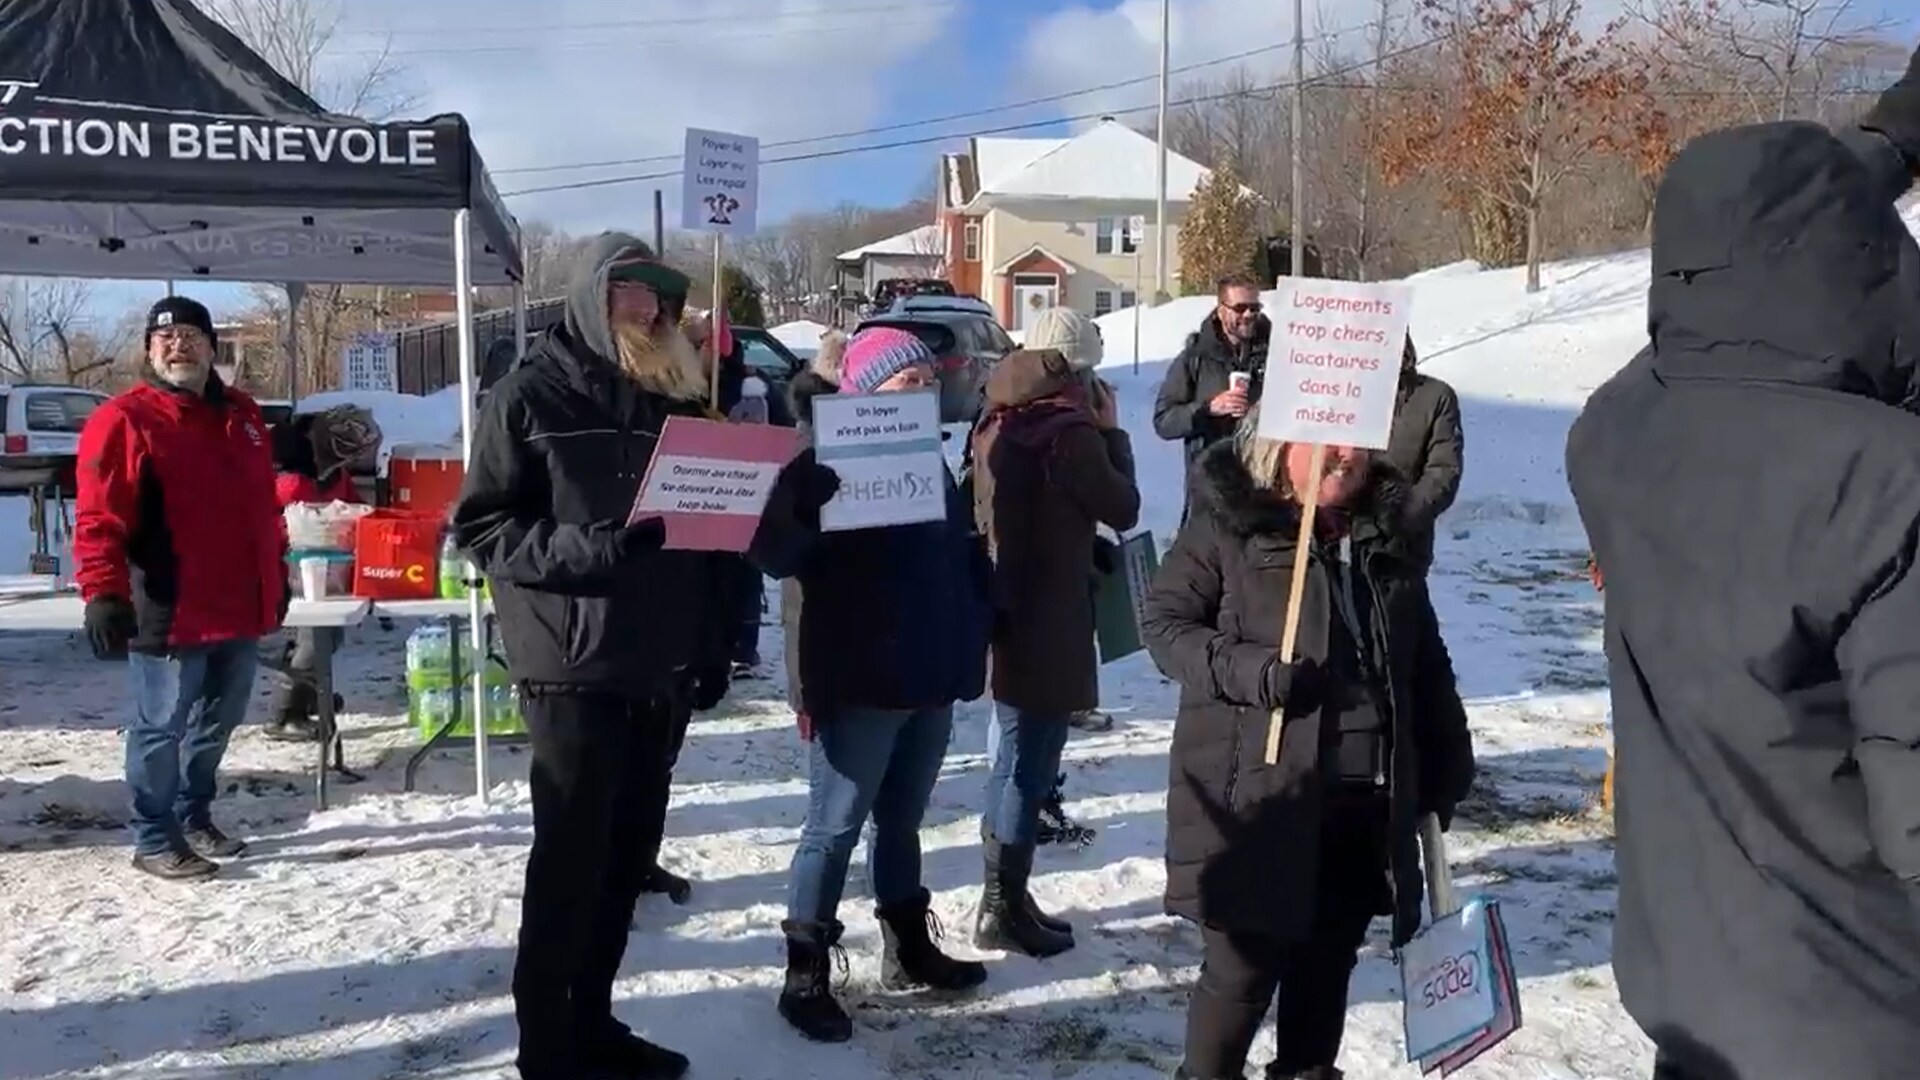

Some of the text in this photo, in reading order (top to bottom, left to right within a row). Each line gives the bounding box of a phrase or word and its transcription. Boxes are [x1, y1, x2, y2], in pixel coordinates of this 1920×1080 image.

[168, 121, 436, 165] BÉNÉVOLE
[1293, 290, 1393, 315] Logements
[1288, 321, 1390, 348] trop chers,
[1290, 348, 1380, 371] locataires
[1299, 378, 1362, 398] dans la
[856, 406, 900, 418] Un loyer
[1296, 406, 1356, 424] misère
[864, 424, 882, 437] pas
[883, 424, 897, 434] un
[362, 564, 425, 583] Super C
